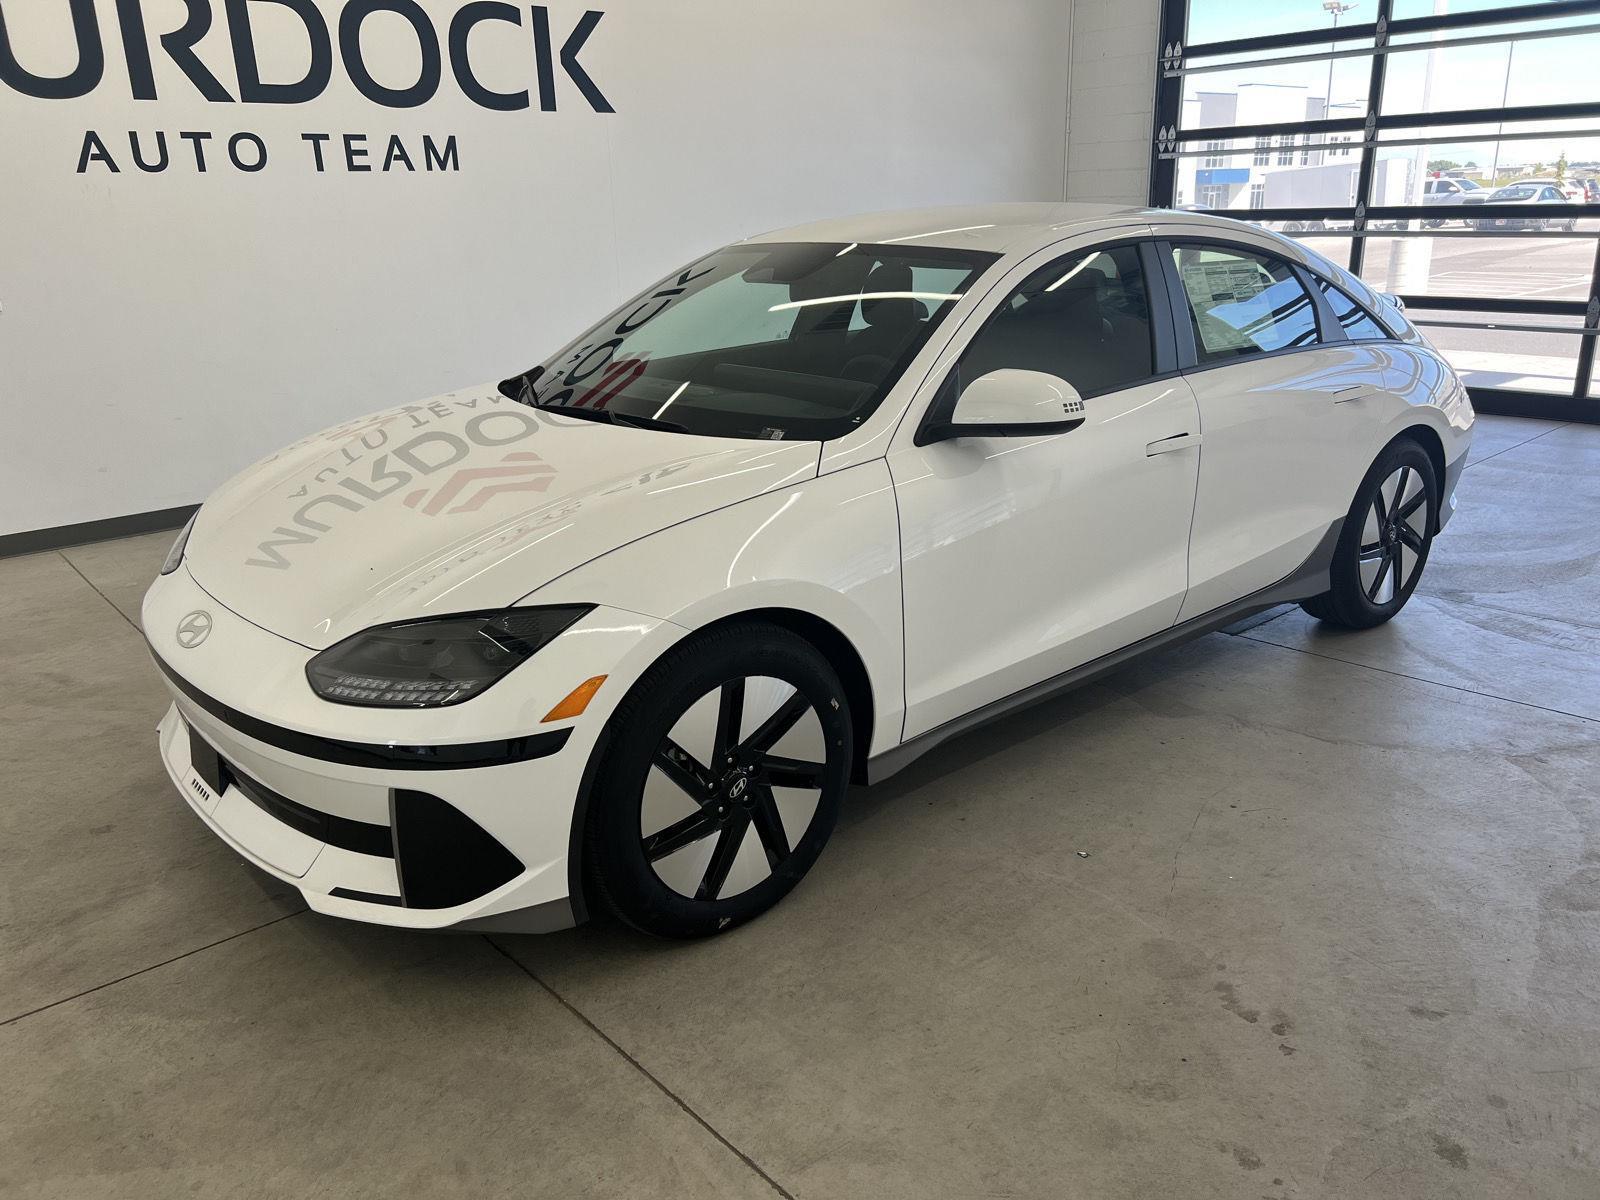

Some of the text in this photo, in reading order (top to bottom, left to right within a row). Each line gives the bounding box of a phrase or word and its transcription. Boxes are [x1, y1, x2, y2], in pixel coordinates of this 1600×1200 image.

[0, 0, 616, 113] URDOCK
[76, 130, 460, 173] AUTO TEAM
